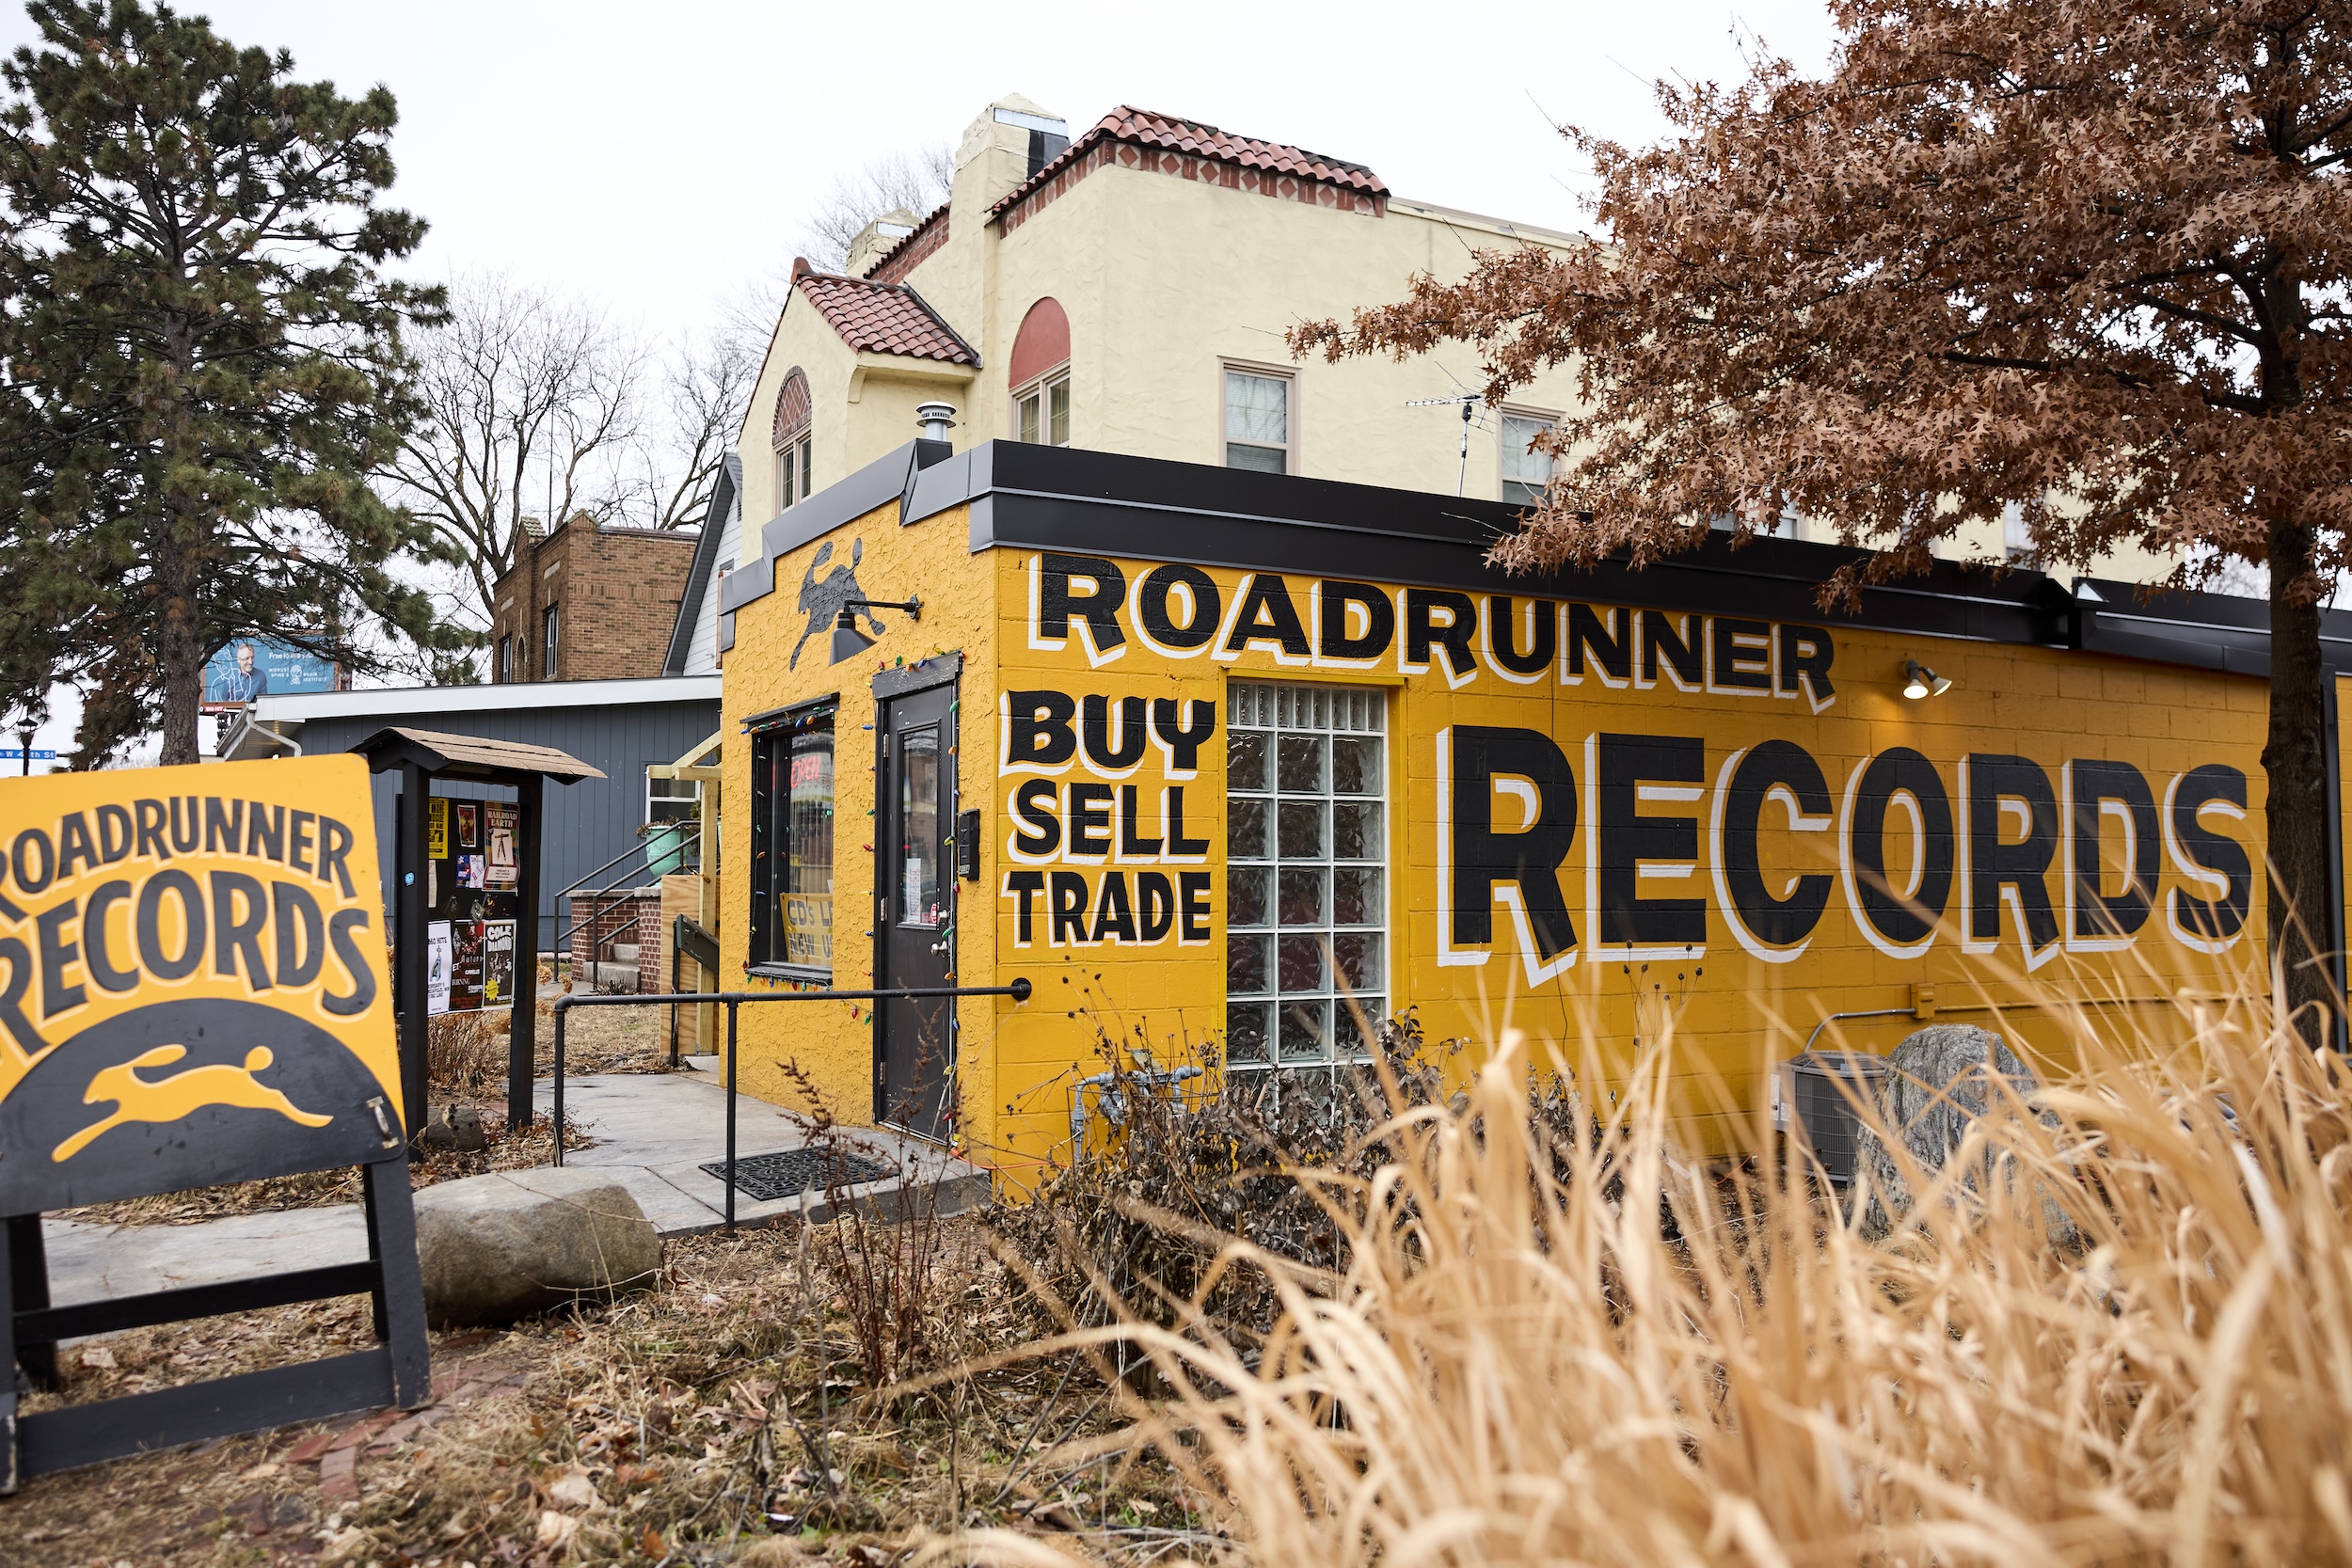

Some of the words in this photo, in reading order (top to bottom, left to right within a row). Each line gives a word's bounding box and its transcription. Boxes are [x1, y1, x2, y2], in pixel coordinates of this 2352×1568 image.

[1028, 553, 1836, 715] ROADRUNNER
[999, 689, 1216, 780] BUY
[791, 752, 820, 788] OPEN
[487, 811, 517, 821] RAILROAD
[491, 818, 514, 828] EARTH
[1007, 778, 1211, 865] SELL
[1437, 725, 2252, 989] RECORDS
[787, 898, 816, 927] CD's
[1001, 870, 1212, 948] TRADE
[487, 926, 512, 941] COLE
[487, 936, 512, 952] DIAMOND
[787, 932, 815, 956] NEW
